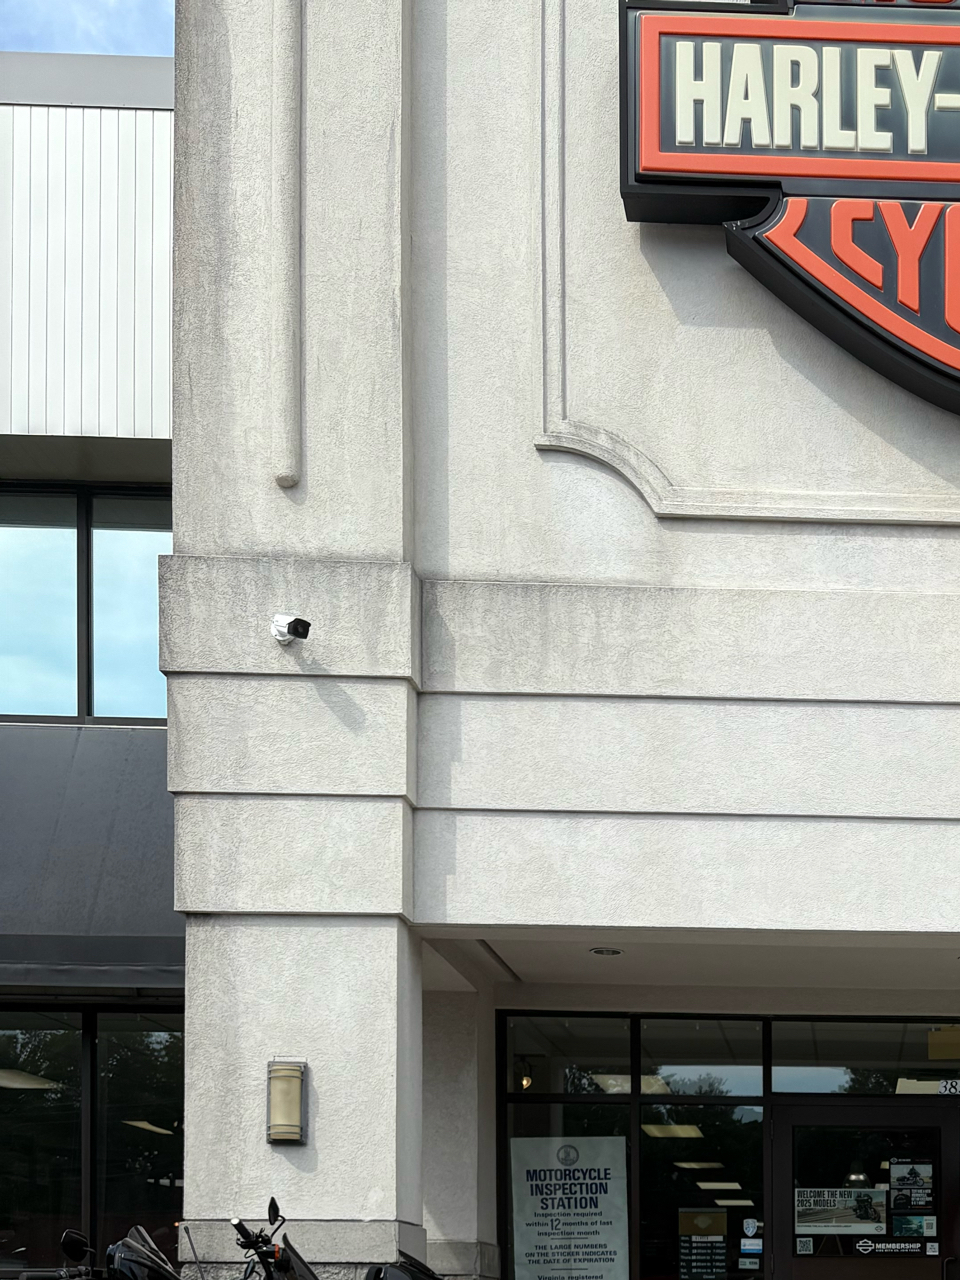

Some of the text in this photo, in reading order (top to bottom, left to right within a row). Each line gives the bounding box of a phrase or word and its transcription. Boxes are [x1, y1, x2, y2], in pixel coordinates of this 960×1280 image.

[526, 1168, 611, 1182] MOTORCYCLE
[530, 1182, 608, 1196] INSPECTION
[797, 1190, 853, 1199] WELCOME THE NEW
[540, 1196, 599, 1210] STATION
[797, 1199, 837, 1208] 2025 MODELS
[534, 1211, 571, 1219] Inspection
[550, 1218, 561, 1231] 12
